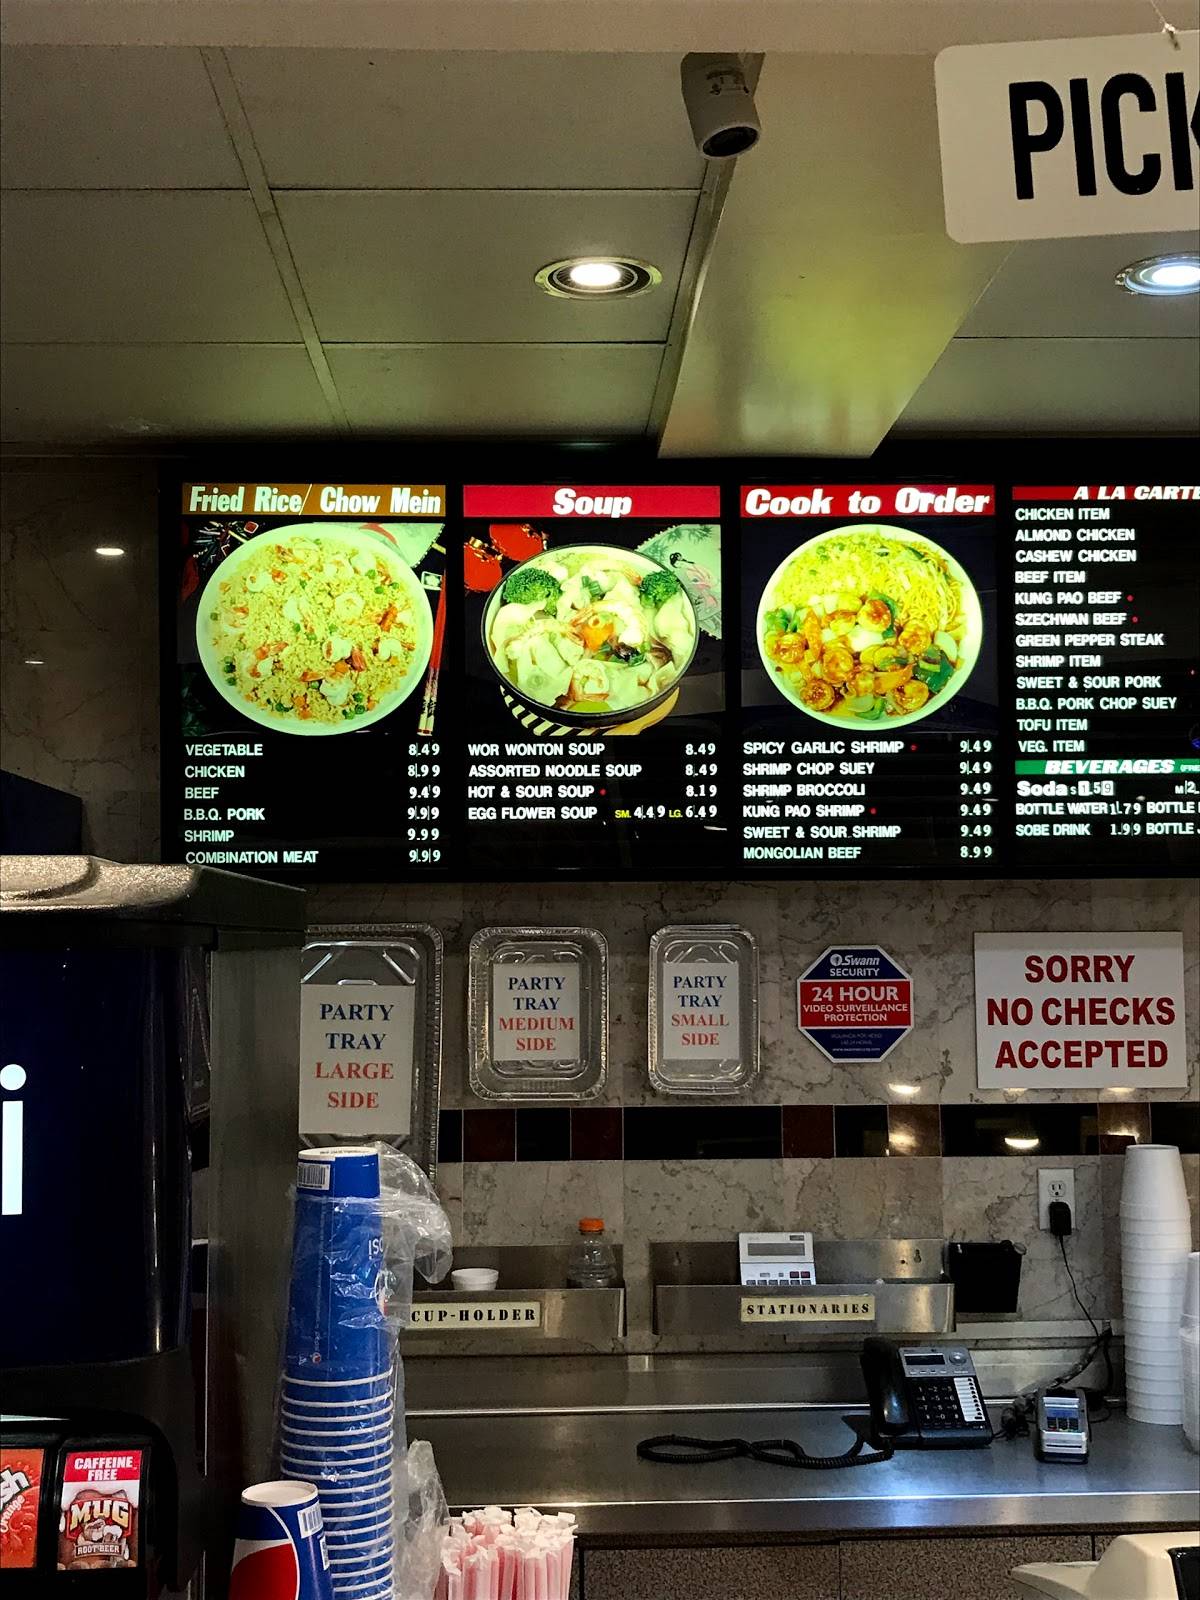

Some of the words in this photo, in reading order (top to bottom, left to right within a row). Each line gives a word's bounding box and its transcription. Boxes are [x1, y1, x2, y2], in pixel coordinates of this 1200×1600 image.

[1073, 486, 1088, 499] A
[1097, 486, 1125, 499] LA
[189, 486, 244, 512] Fried
[320, 487, 380, 513] Chow
[390, 488, 441, 514] Mein
[552, 489, 632, 517] Soup
[745, 488, 833, 516] Cook
[848, 490, 880, 514] to
[894, 487, 990, 514] Order
[1015, 508, 1073, 520] CHICKEN
[1078, 508, 1110, 520] ITEM
[1015, 529, 1072, 541] ALMOND
[1077, 529, 1135, 541] CHICKEN
[1015, 550, 1073, 562] CASHEW
[1078, 550, 1137, 562] CHICKEN
[1015, 571, 1049, 583] BEEF
[1053, 571, 1085, 583] ITEM
[1015, 592, 1052, 604] KUNG
[1057, 592, 1083, 604] PAO
[1088, 592, 1122, 604] BEEF
[1015, 613, 1088, 625] SZECHWAN
[1093, 613, 1127, 625] BEEF
[1015, 635, 1060, 647] GREEN
[1065, 634, 1115, 646] PEPPER
[1120, 634, 1164, 645] STEAK
[1015, 655, 1064, 668] SHRIMP
[1069, 655, 1101, 667] ITEM
[1016, 677, 1063, 689] SWEET
[1068, 676, 1078, 688] &
[1083, 676, 1120, 688] SOUR
[1125, 676, 1161, 688] PORK
[1016, 698, 1052, 710] B.B.Q.
[1058, 698, 1094, 709] PORK
[1100, 698, 1137, 709] CHOP
[1142, 697, 1177, 709] SUEY
[1017, 719, 1051, 731] TOFU
[1056, 719, 1087, 730] ITEM
[186, 744, 263, 756] VEGETABLE
[408, 744, 440, 756] 8.49
[468, 744, 499, 756] WOR
[505, 744, 563, 755] WONTON
[568, 744, 605, 755] SOUP
[685, 744, 716, 755] 8.49
[743, 742, 784, 754] SPICY
[791, 742, 845, 754] GARLIC
[851, 741, 904, 753] SHRIMP
[960, 740, 992, 753] 9.49
[1018, 741, 1048, 752] VEG.
[1053, 740, 1085, 751] ITEM
[185, 766, 245, 778] CHICKEN
[408, 764, 441, 777] 8.99
[469, 765, 540, 777] ASSORTED
[545, 765, 600, 777] NOODLE
[606, 765, 642, 776] SOUP
[685, 764, 717, 776] 8.49
[743, 763, 791, 775] SHRIMP
[797, 763, 834, 775] CHOP
[839, 762, 875, 774] SUEY
[960, 761, 992, 774] 9.49
[1045, 760, 1175, 774] BEVERAGES
[185, 787, 219, 799] BEEF
[409, 786, 441, 799] 9.49
[468, 786, 495, 798] HOT
[501, 786, 510, 798] &
[516, 786, 552, 798] SOUR
[558, 786, 594, 797] SOUP
[686, 785, 717, 797] 8.19
[743, 784, 792, 797] SHRIMP
[797, 784, 865, 796] BROCCOLI
[960, 783, 992, 795] 9.49
[1017, 781, 1068, 796] Soda
[408, 807, 439, 820] 9.99
[468, 808, 496, 819] EGG
[501, 807, 555, 819] FLOWER
[561, 807, 597, 819] SOUP
[615, 810, 631, 818] SM.
[634, 806, 665, 819] 4.49
[669, 810, 683, 818] LG.
[686, 805, 717, 818] 6.49
[743, 805, 780, 817] KUNG
[784, 805, 811, 817] PAO
[816, 805, 865, 817] SHRIMP
[960, 804, 992, 816] 9.49
[1016, 803, 1064, 815] BOTTLE
[1068, 803, 1108, 814] WATER
[1147, 802, 1195, 813] BOTTLE
[184, 809, 222, 821] B.B.Q.
[227, 808, 265, 820] PORK
[743, 826, 790, 838] SWEET
[796, 826, 805, 838] &
[810, 826, 847, 838] SOUR
[852, 826, 901, 838] SHRIMP
[961, 825, 992, 837] 9.49
[1016, 824, 1049, 836] SOBE
[1053, 824, 1091, 835] DRINK
[1110, 823, 1141, 835] 1.99
[1146, 823, 1194, 834] BOTTLE
[184, 829, 234, 842] SHRIMP
[408, 829, 440, 841] 9.99
[186, 851, 277, 864] COMBINATION
[283, 850, 318, 863] MEAT
[409, 850, 441, 863] 9.99
[743, 847, 823, 859] MONGOLIAN
[828, 847, 861, 859] BEEF
[960, 846, 992, 858] 8.99
[842, 955, 879, 966] Swann
[830, 968, 879, 976] SECURITY
[1025, 955, 1136, 983] SORRY
[509, 977, 566, 990] PARTY
[674, 976, 727, 988] PARTY
[812, 987, 833, 1001] 24
[840, 986, 899, 1001] HOUR
[513, 997, 560, 1010] TRAY
[678, 995, 722, 1007] TRAY
[320, 1004, 394, 1020] PARTY
[836, 1004, 908, 1012] SURVEILLANCE
[987, 998, 1033, 1025] NO
[1041, 997, 1175, 1025] CHECKS
[500, 1017, 574, 1030] MEDIUM
[671, 1014, 729, 1026] SMALL
[325, 1033, 386, 1049] TRAY
[516, 1037, 556, 1051] SIDE
[682, 1033, 719, 1045] SIDE
[995, 1040, 1168, 1068] ACCEPTED
[316, 1062, 394, 1079] LARGE
[328, 1092, 379, 1108] SIDE
[411, 1309, 535, 1322] CUP-HOLDER
[747, 1304, 869, 1315] STATIONARIES
[75, 1457, 133, 1469] CAFFEINE
[88, 1469, 117, 1481] FREE
[70, 1500, 129, 1531] MUG
[78, 1546, 98, 1554] ROOT
[100, 1545, 120, 1553] BEER
